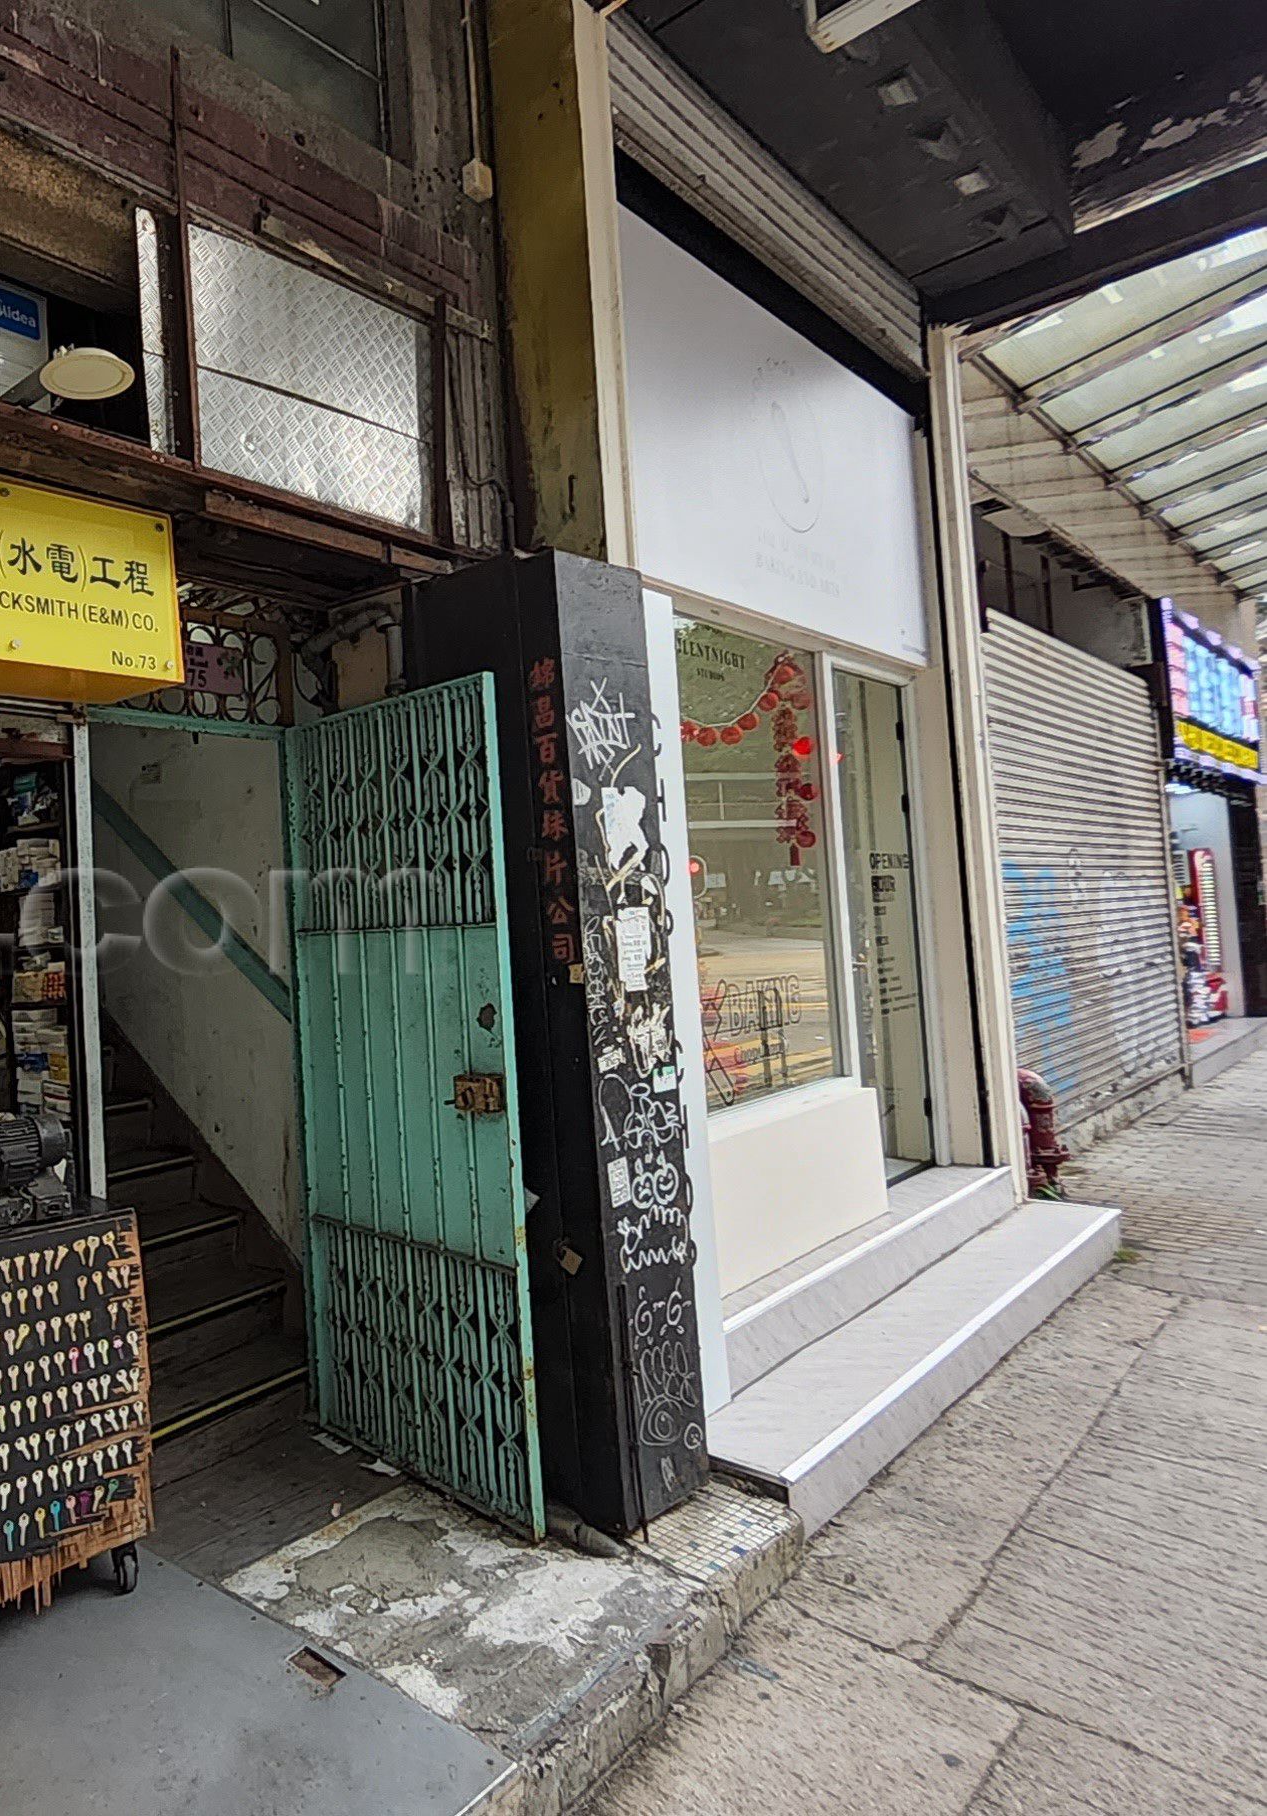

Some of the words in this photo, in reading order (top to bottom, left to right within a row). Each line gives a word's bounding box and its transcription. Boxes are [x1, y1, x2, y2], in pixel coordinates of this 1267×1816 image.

[82, 603, 129, 629] (E&M)
[132, 613, 160, 633] CO.
[111, 649, 158, 671] No.73
